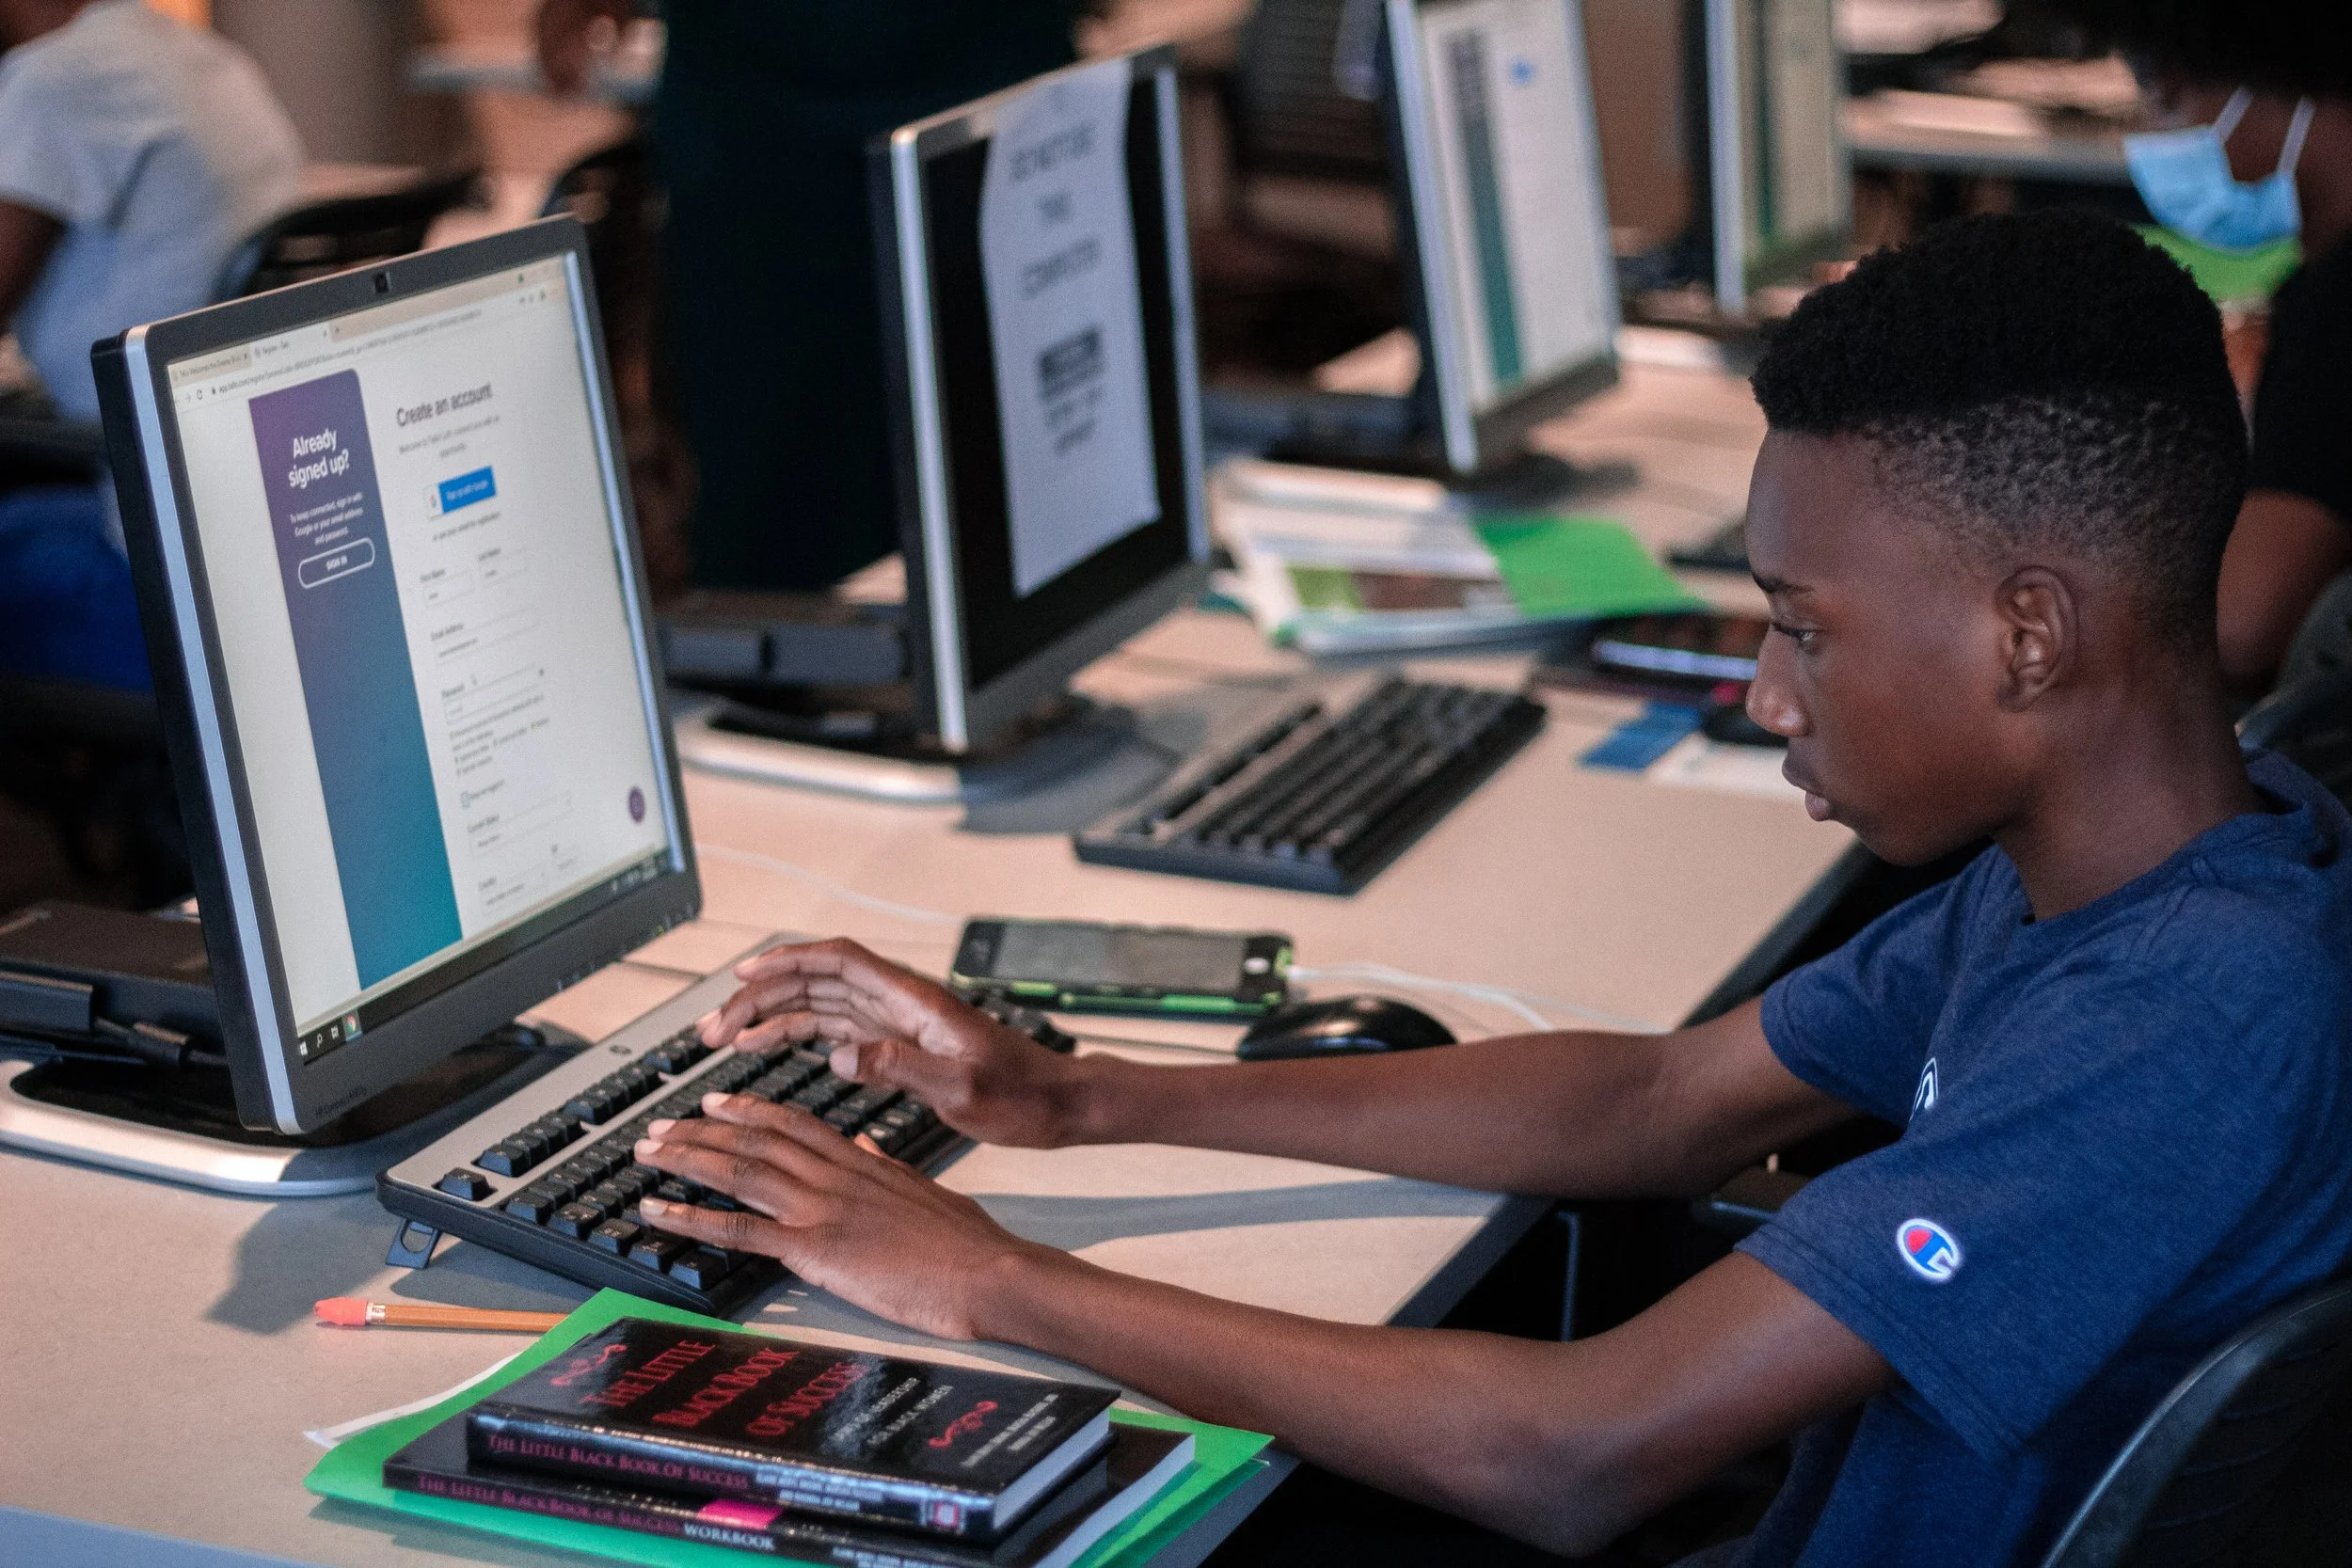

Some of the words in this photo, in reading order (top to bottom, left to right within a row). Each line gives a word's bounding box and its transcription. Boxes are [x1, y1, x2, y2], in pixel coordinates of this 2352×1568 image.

[396, 401, 433, 427] Create
[435, 397, 450, 416] an
[451, 382, 492, 411] account
[293, 428, 337, 459] Already
[288, 456, 328, 489] signed
[329, 449, 350, 476] up?
[579, 1377, 656, 1407] THE
[624, 1340, 716, 1381] LITTLE
[653, 1385, 745, 1427] BLACK
[713, 1347, 799, 1386] BOOK
[766, 1362, 872, 1417] SUCCESS
[745, 1412, 795, 1437] OF
[884, 1411, 921, 1431] BLACK
[911, 1385, 955, 1410] WOMEN
[487, 1434, 516, 1452] THE
[521, 1438, 564, 1459] LITTLE
[570, 1448, 615, 1467] BLACK
[619, 1456, 661, 1475] BOOK
[663, 1463, 683, 1478] OF
[688, 1465, 748, 1490] SUCCESS
[418, 1475, 445, 1494] THE
[451, 1481, 496, 1502] LITTLE
[501, 1489, 547, 1510] BLACK
[549, 1497, 589, 1517] BOOK
[595, 1508, 613, 1520] OF
[684, 1523, 775, 1550] WORKBOOK
